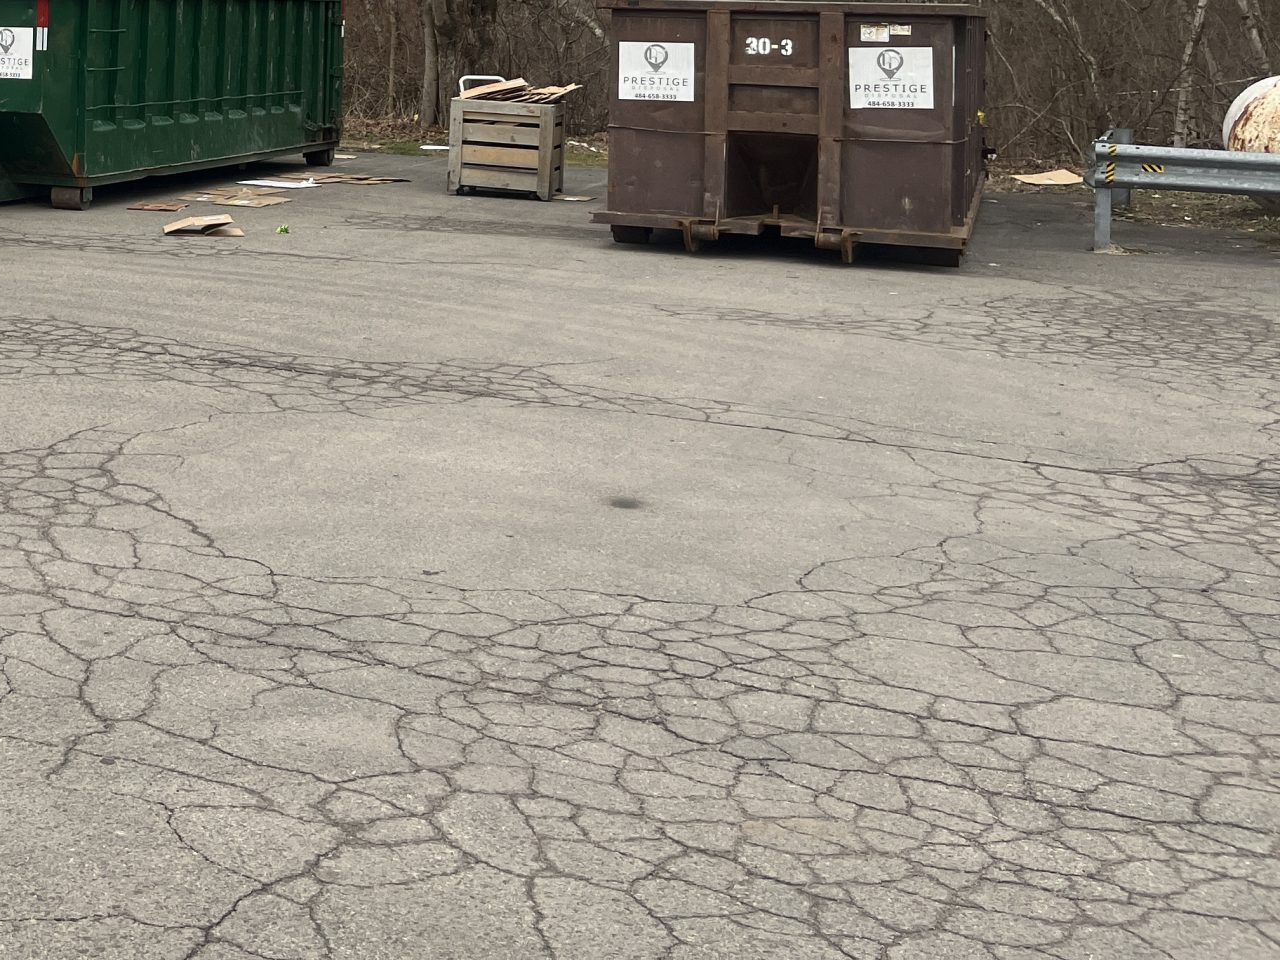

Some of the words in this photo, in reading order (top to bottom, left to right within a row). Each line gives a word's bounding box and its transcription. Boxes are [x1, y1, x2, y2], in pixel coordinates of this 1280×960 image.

[745, 37, 793, 56] 30-3
[623, 76, 688, 87] PRESTIGE
[854, 84, 927, 93] PRESTIGE
